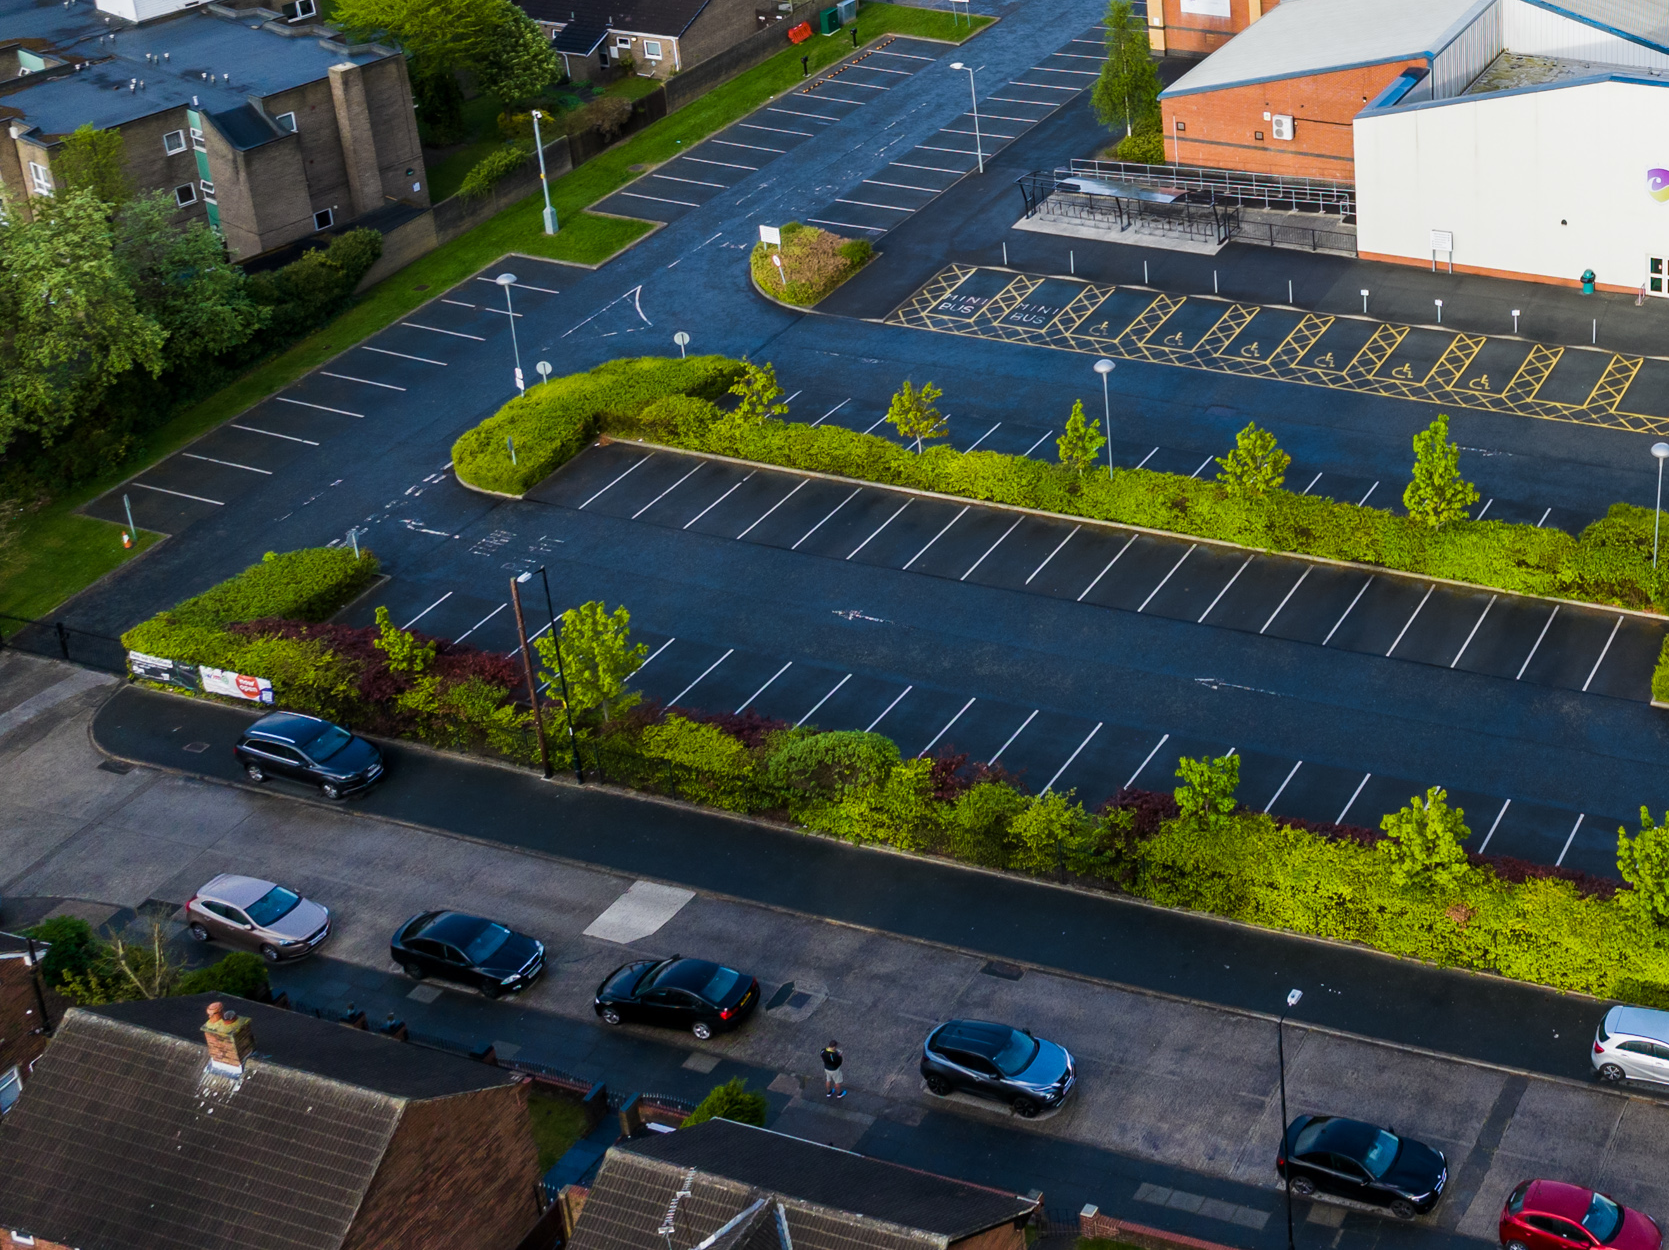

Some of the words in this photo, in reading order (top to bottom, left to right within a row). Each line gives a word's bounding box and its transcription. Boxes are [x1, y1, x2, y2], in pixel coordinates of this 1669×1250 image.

[943, 293, 989, 305] MINI
[938, 302, 975, 314] BUS
[1015, 303, 1060, 315] MINI
[1009, 312, 1046, 325] BUS
